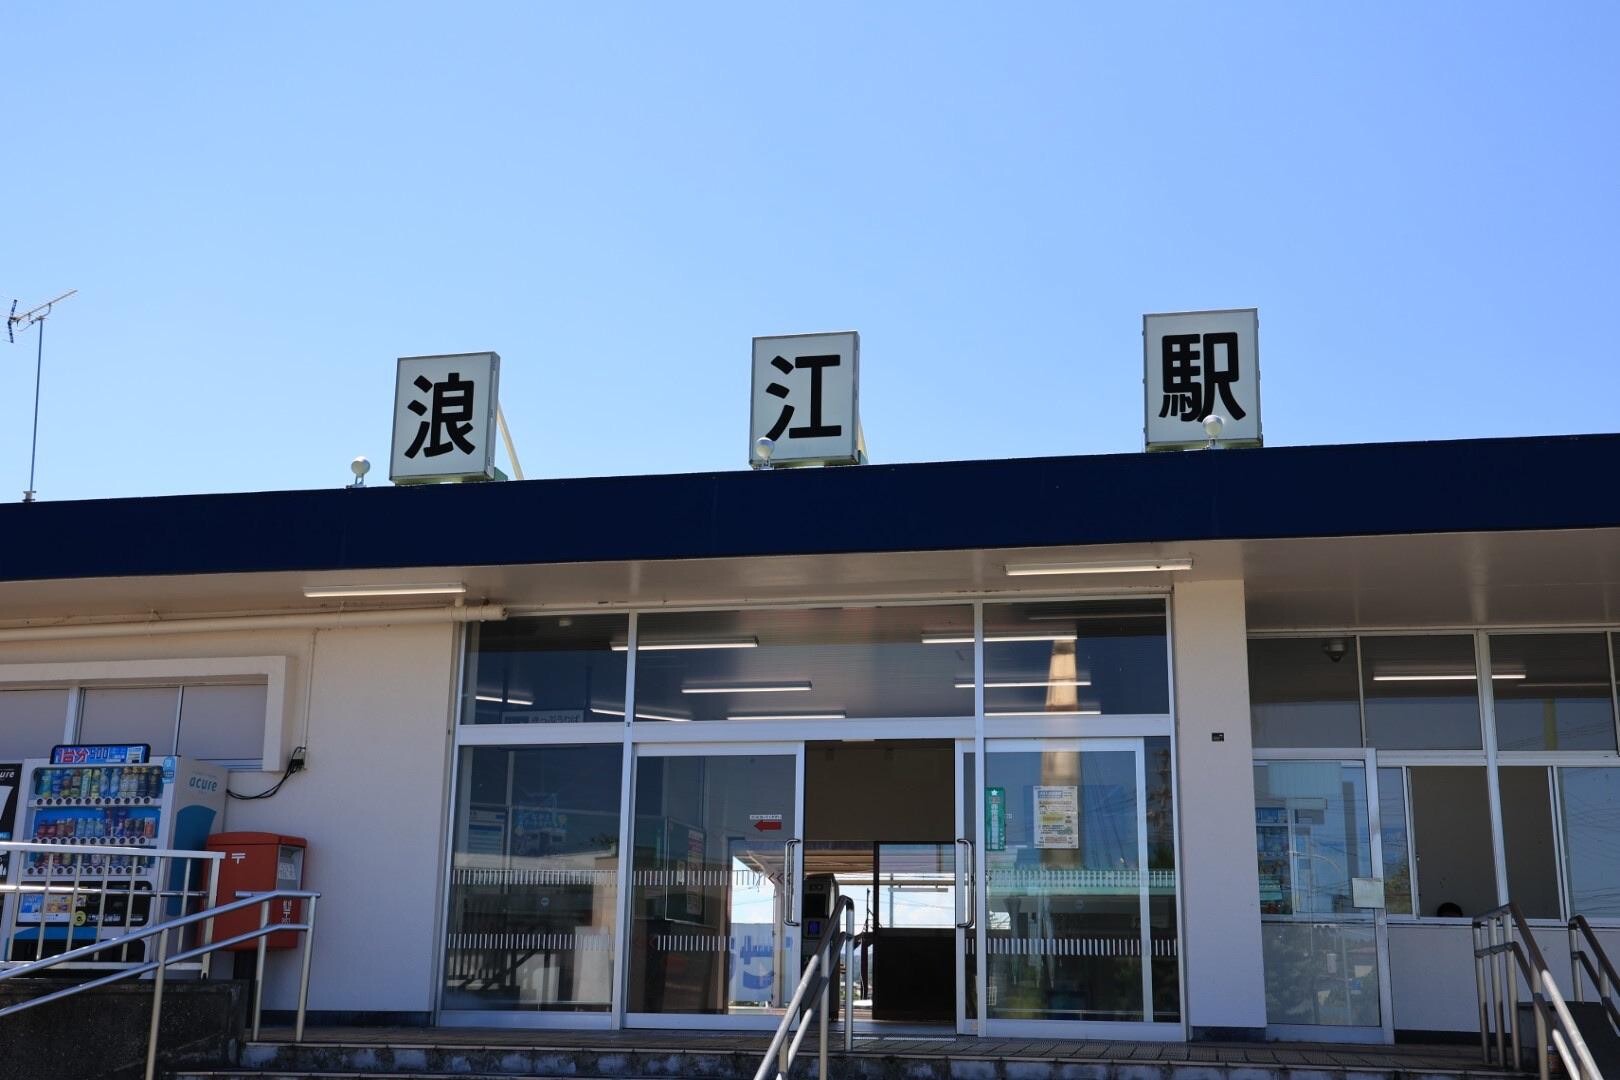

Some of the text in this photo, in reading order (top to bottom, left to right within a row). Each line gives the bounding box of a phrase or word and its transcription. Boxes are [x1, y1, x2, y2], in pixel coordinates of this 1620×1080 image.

[404, 331, 1247, 459] 浪 江 駅
[189, 776, 218, 792] acure
